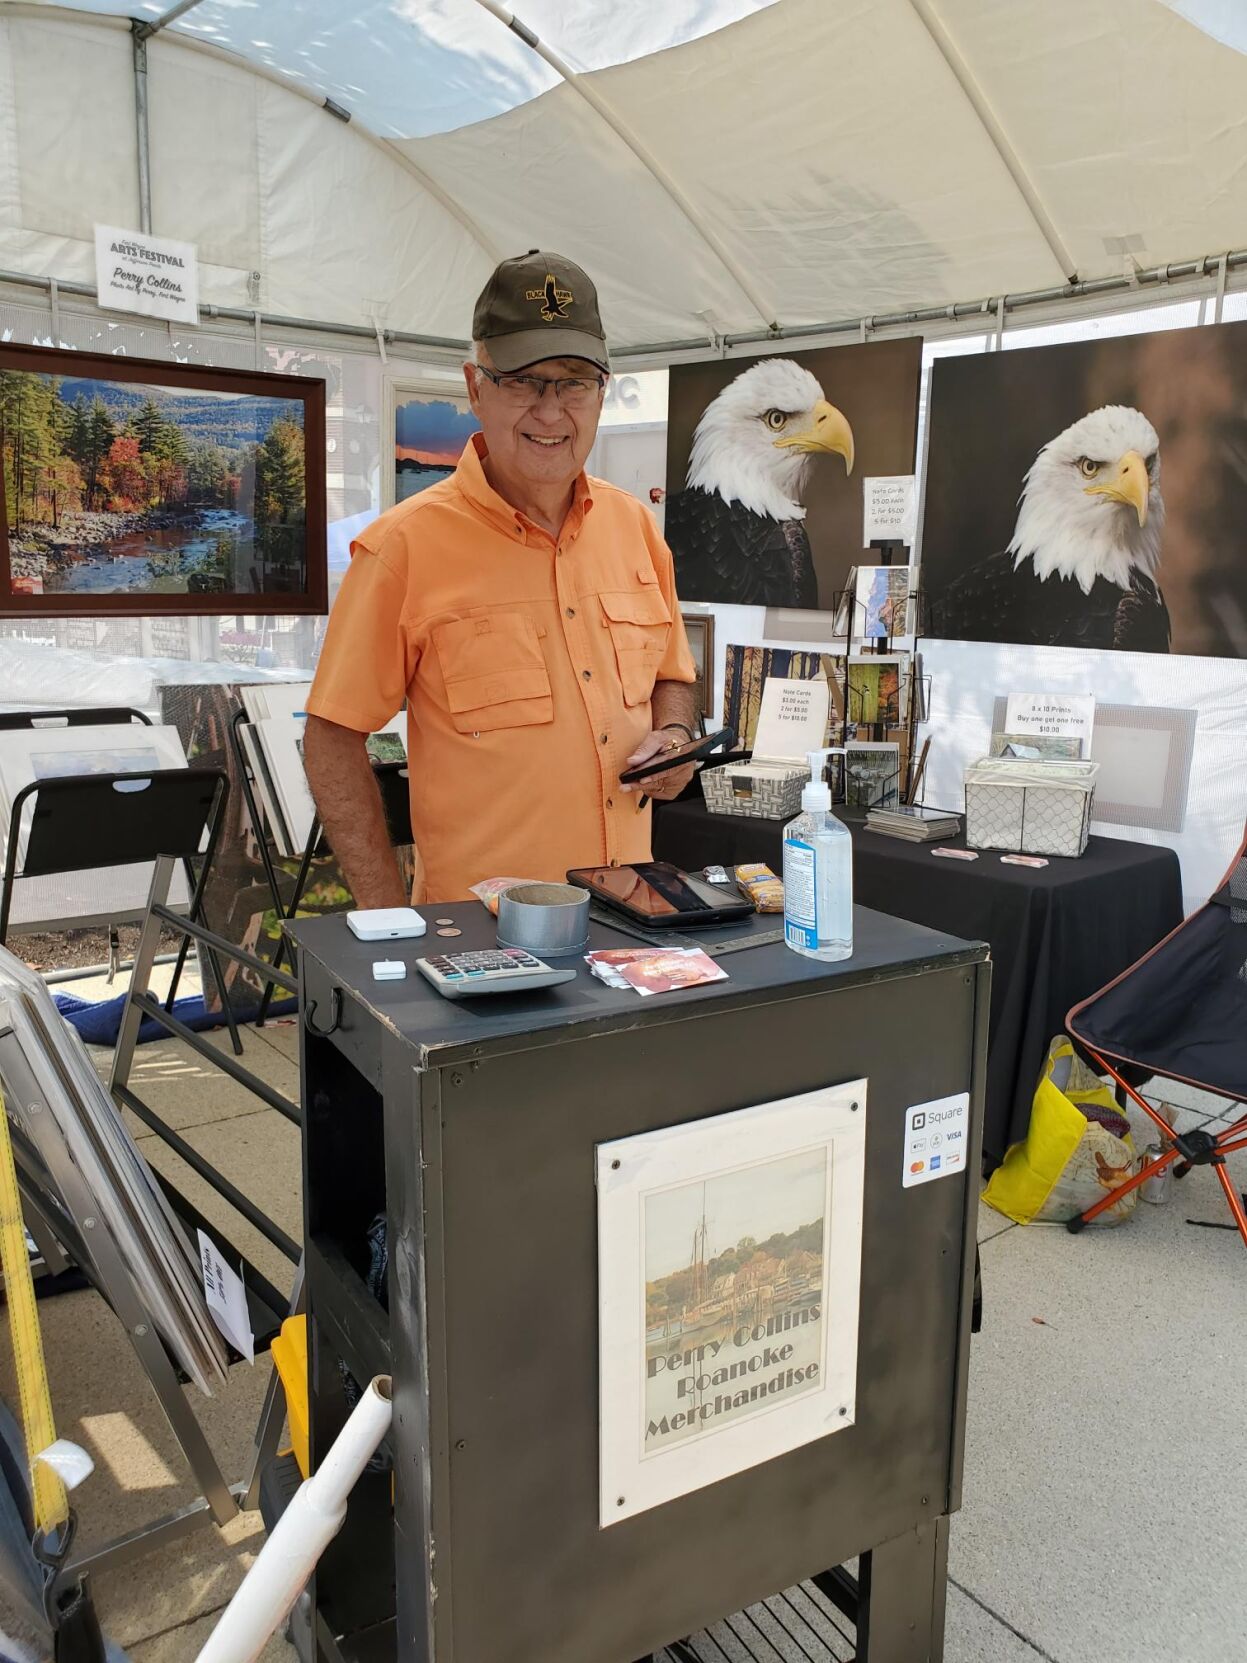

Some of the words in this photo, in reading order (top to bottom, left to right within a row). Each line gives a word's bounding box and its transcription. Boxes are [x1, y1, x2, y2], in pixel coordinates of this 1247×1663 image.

[110, 243, 138, 256] ARTS
[139, 249, 185, 268] FESTIVAL
[113, 267, 144, 286] Perry
[146, 274, 183, 293] Collins
[1017, 715, 1030, 723] Buy
[928, 1107, 963, 1125] Square
[946, 1130, 962, 1141] VISA
[647, 1337, 726, 1379] Perry
[733, 1304, 821, 1348] Collins
[677, 1344, 794, 1399] Roanoke
[645, 1362, 820, 1441] Merchandise
